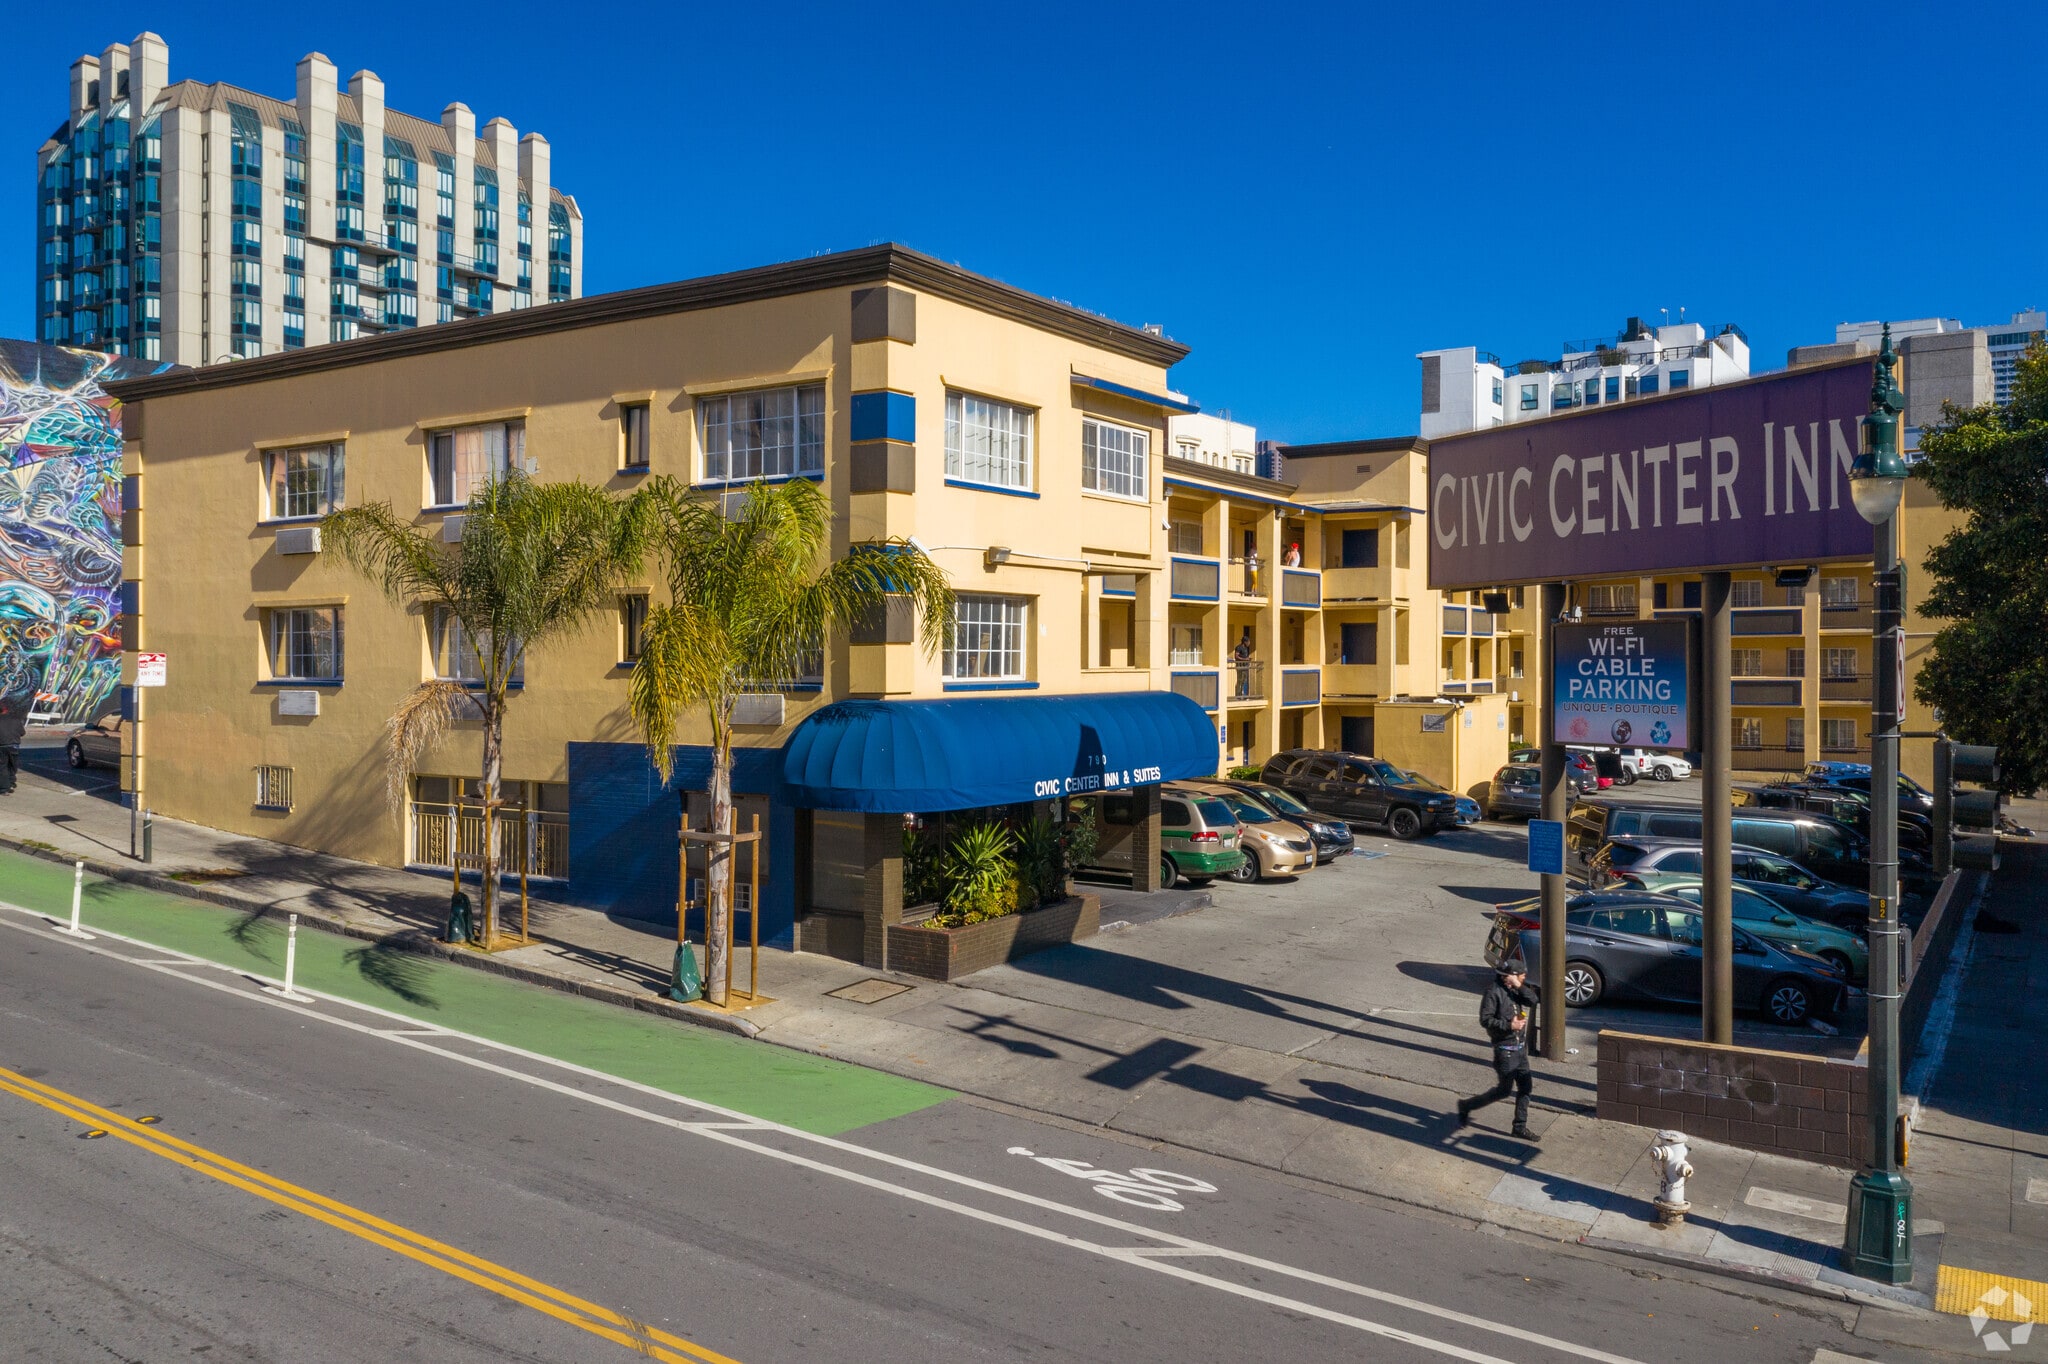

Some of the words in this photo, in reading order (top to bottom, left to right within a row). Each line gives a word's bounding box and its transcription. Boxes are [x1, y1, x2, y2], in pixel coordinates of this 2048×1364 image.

[1434, 466, 1533, 550] CIVIC
[1548, 436, 1742, 539] CENTER
[1764, 414, 1866, 517] INN
[1603, 627, 1634, 636] FREE
[1588, 637, 1645, 656] WI-FI
[1578, 658, 1655, 676] CABLE
[1569, 679, 1671, 700] PARKING
[1563, 702, 1607, 713] UNIQUE
[1614, 704, 1678, 715] BOUTIQUE
[1088, 754, 1107, 768] 790
[1035, 779, 1060, 797] CIVIC
[1065, 774, 1100, 792] CENTER
[1104, 771, 1119, 787] INN
[1123, 770, 1130, 784] &
[1134, 766, 1161, 783] SUITES
